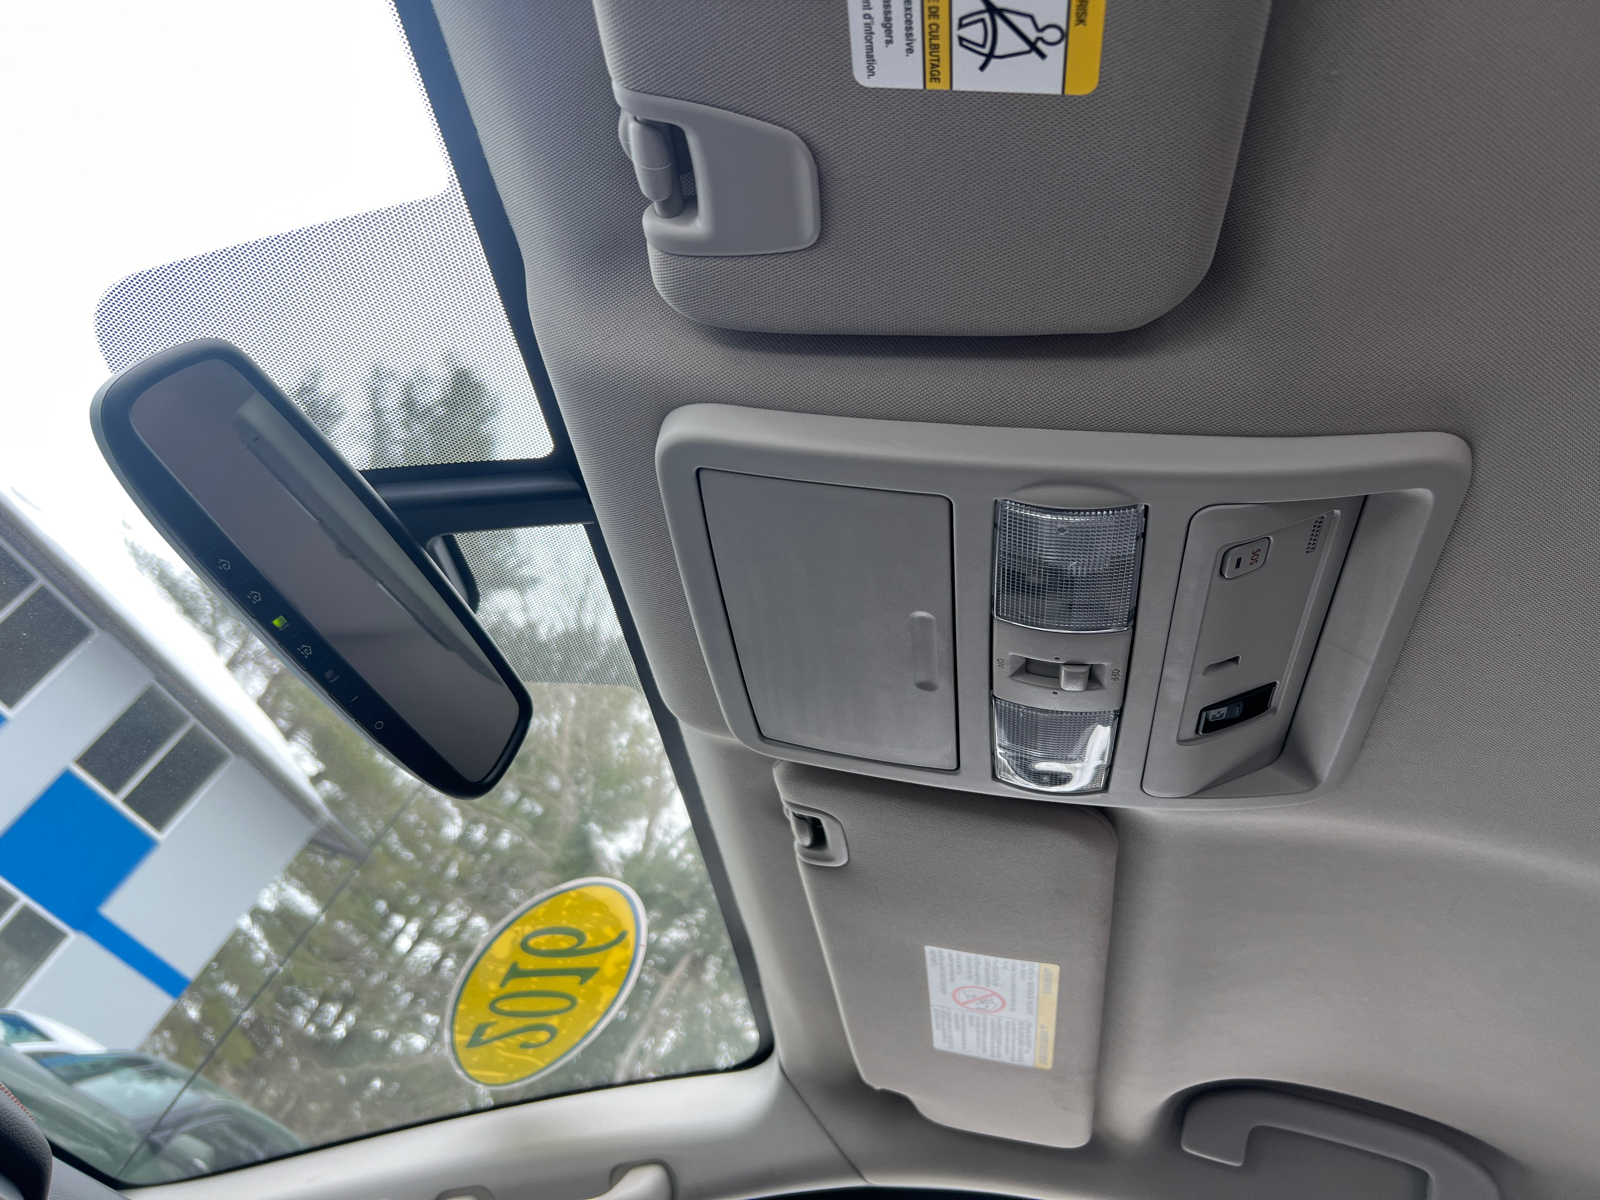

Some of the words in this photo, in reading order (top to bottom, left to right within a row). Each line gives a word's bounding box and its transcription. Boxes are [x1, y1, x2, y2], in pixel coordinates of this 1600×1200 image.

[881, 0, 894, 48] assagers.
[904, 0, 917, 57] excessive.
[928, 6, 940, 20] DE
[863, 13, 877, 79] d'information.
[928, 23, 941, 83] CULBUTAGE
[1249, 549, 1261, 566] SOS
[996, 657, 1005, 668] ON
[1111, 668, 1121, 681] OFF
